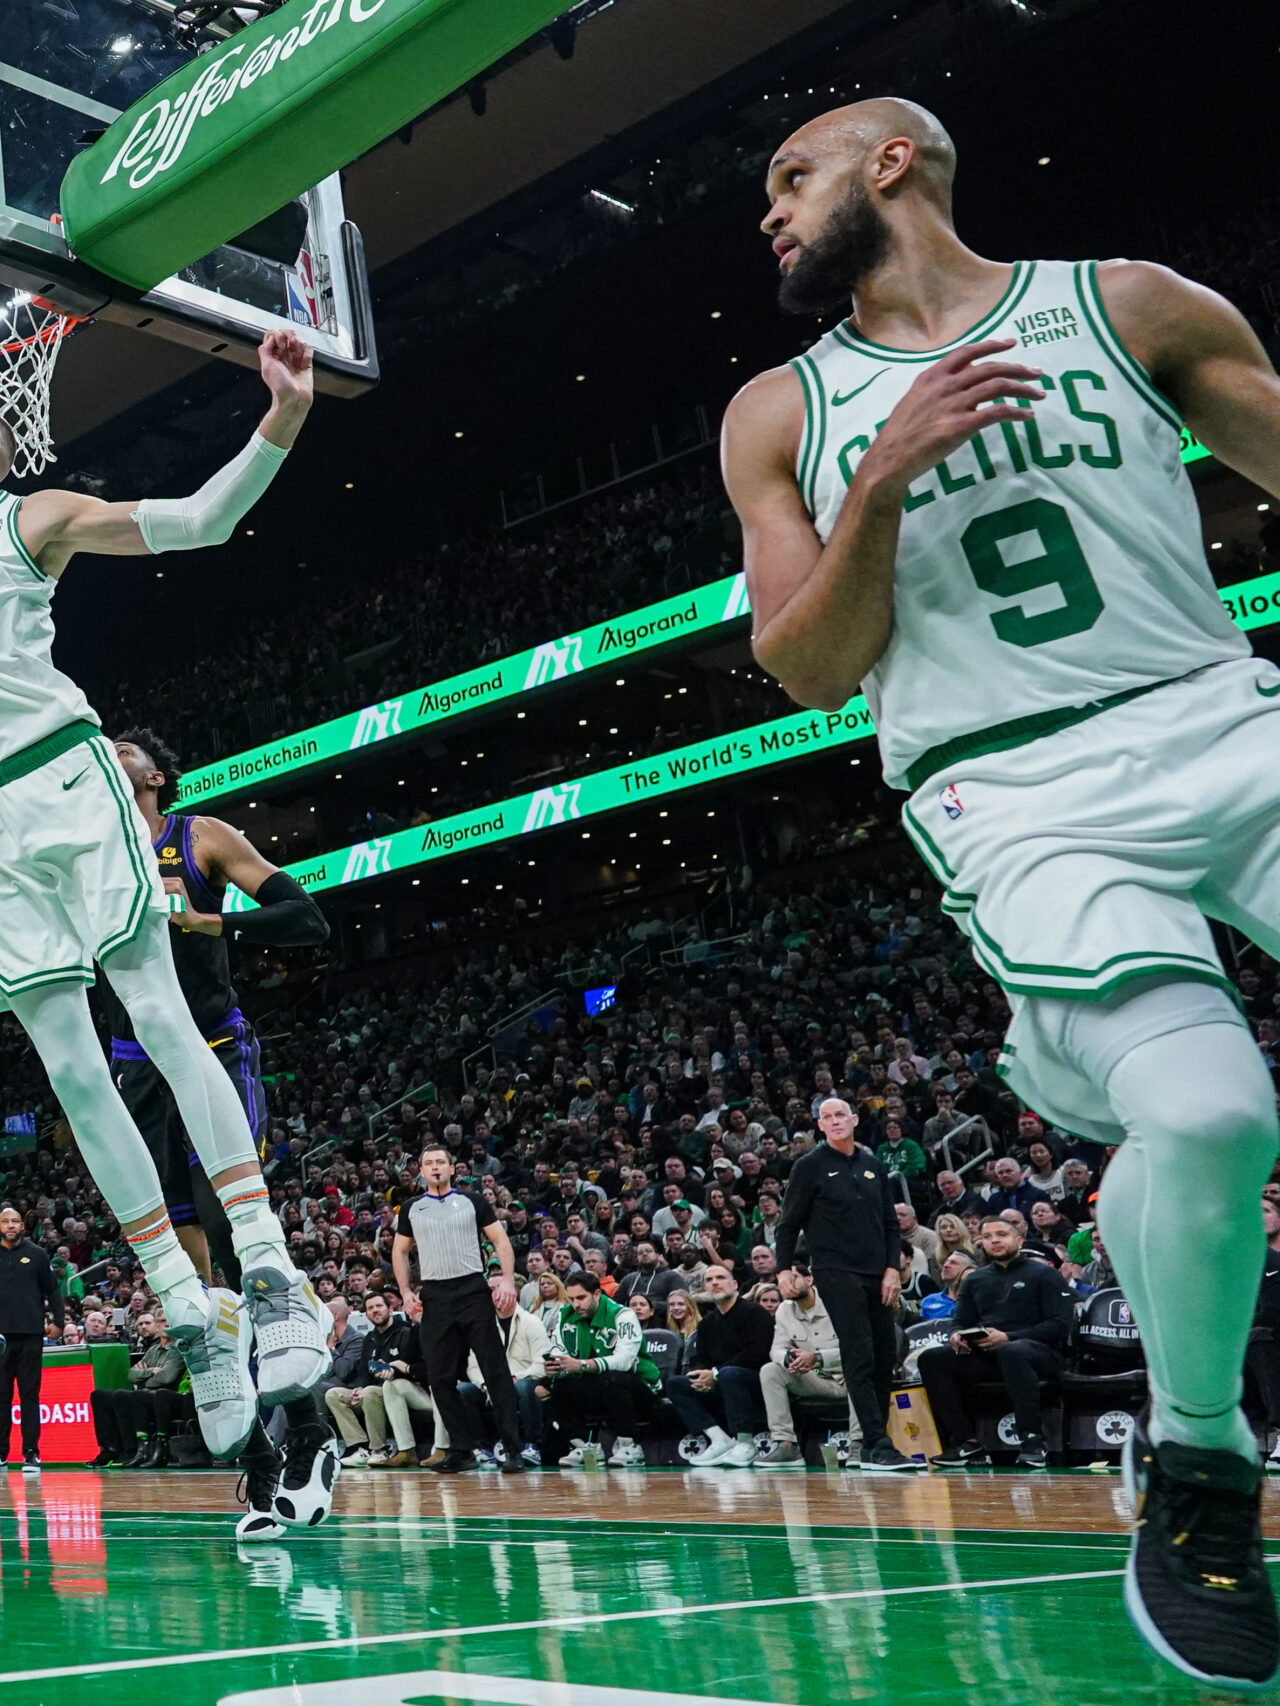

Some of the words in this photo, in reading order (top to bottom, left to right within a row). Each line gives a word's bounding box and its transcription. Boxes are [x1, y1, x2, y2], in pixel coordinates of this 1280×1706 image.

[293, 308, 308, 323] NBA
[1014, 306, 1077, 334] VISTA
[1021, 322, 1079, 348] PRINT
[961, 498, 1105, 648] 9
[597, 601, 698, 654] Algorand
[417, 671, 503, 717] Algorand
[228, 738, 318, 782] Blockchain
[620, 770, 661, 793] The
[667, 742, 752, 779] World's
[759, 719, 821, 754] Most
[421, 812, 504, 852] Algorand
[1090, 1326, 1119, 1338] ACCESS.
[1119, 1328, 1131, 1339] ALL
